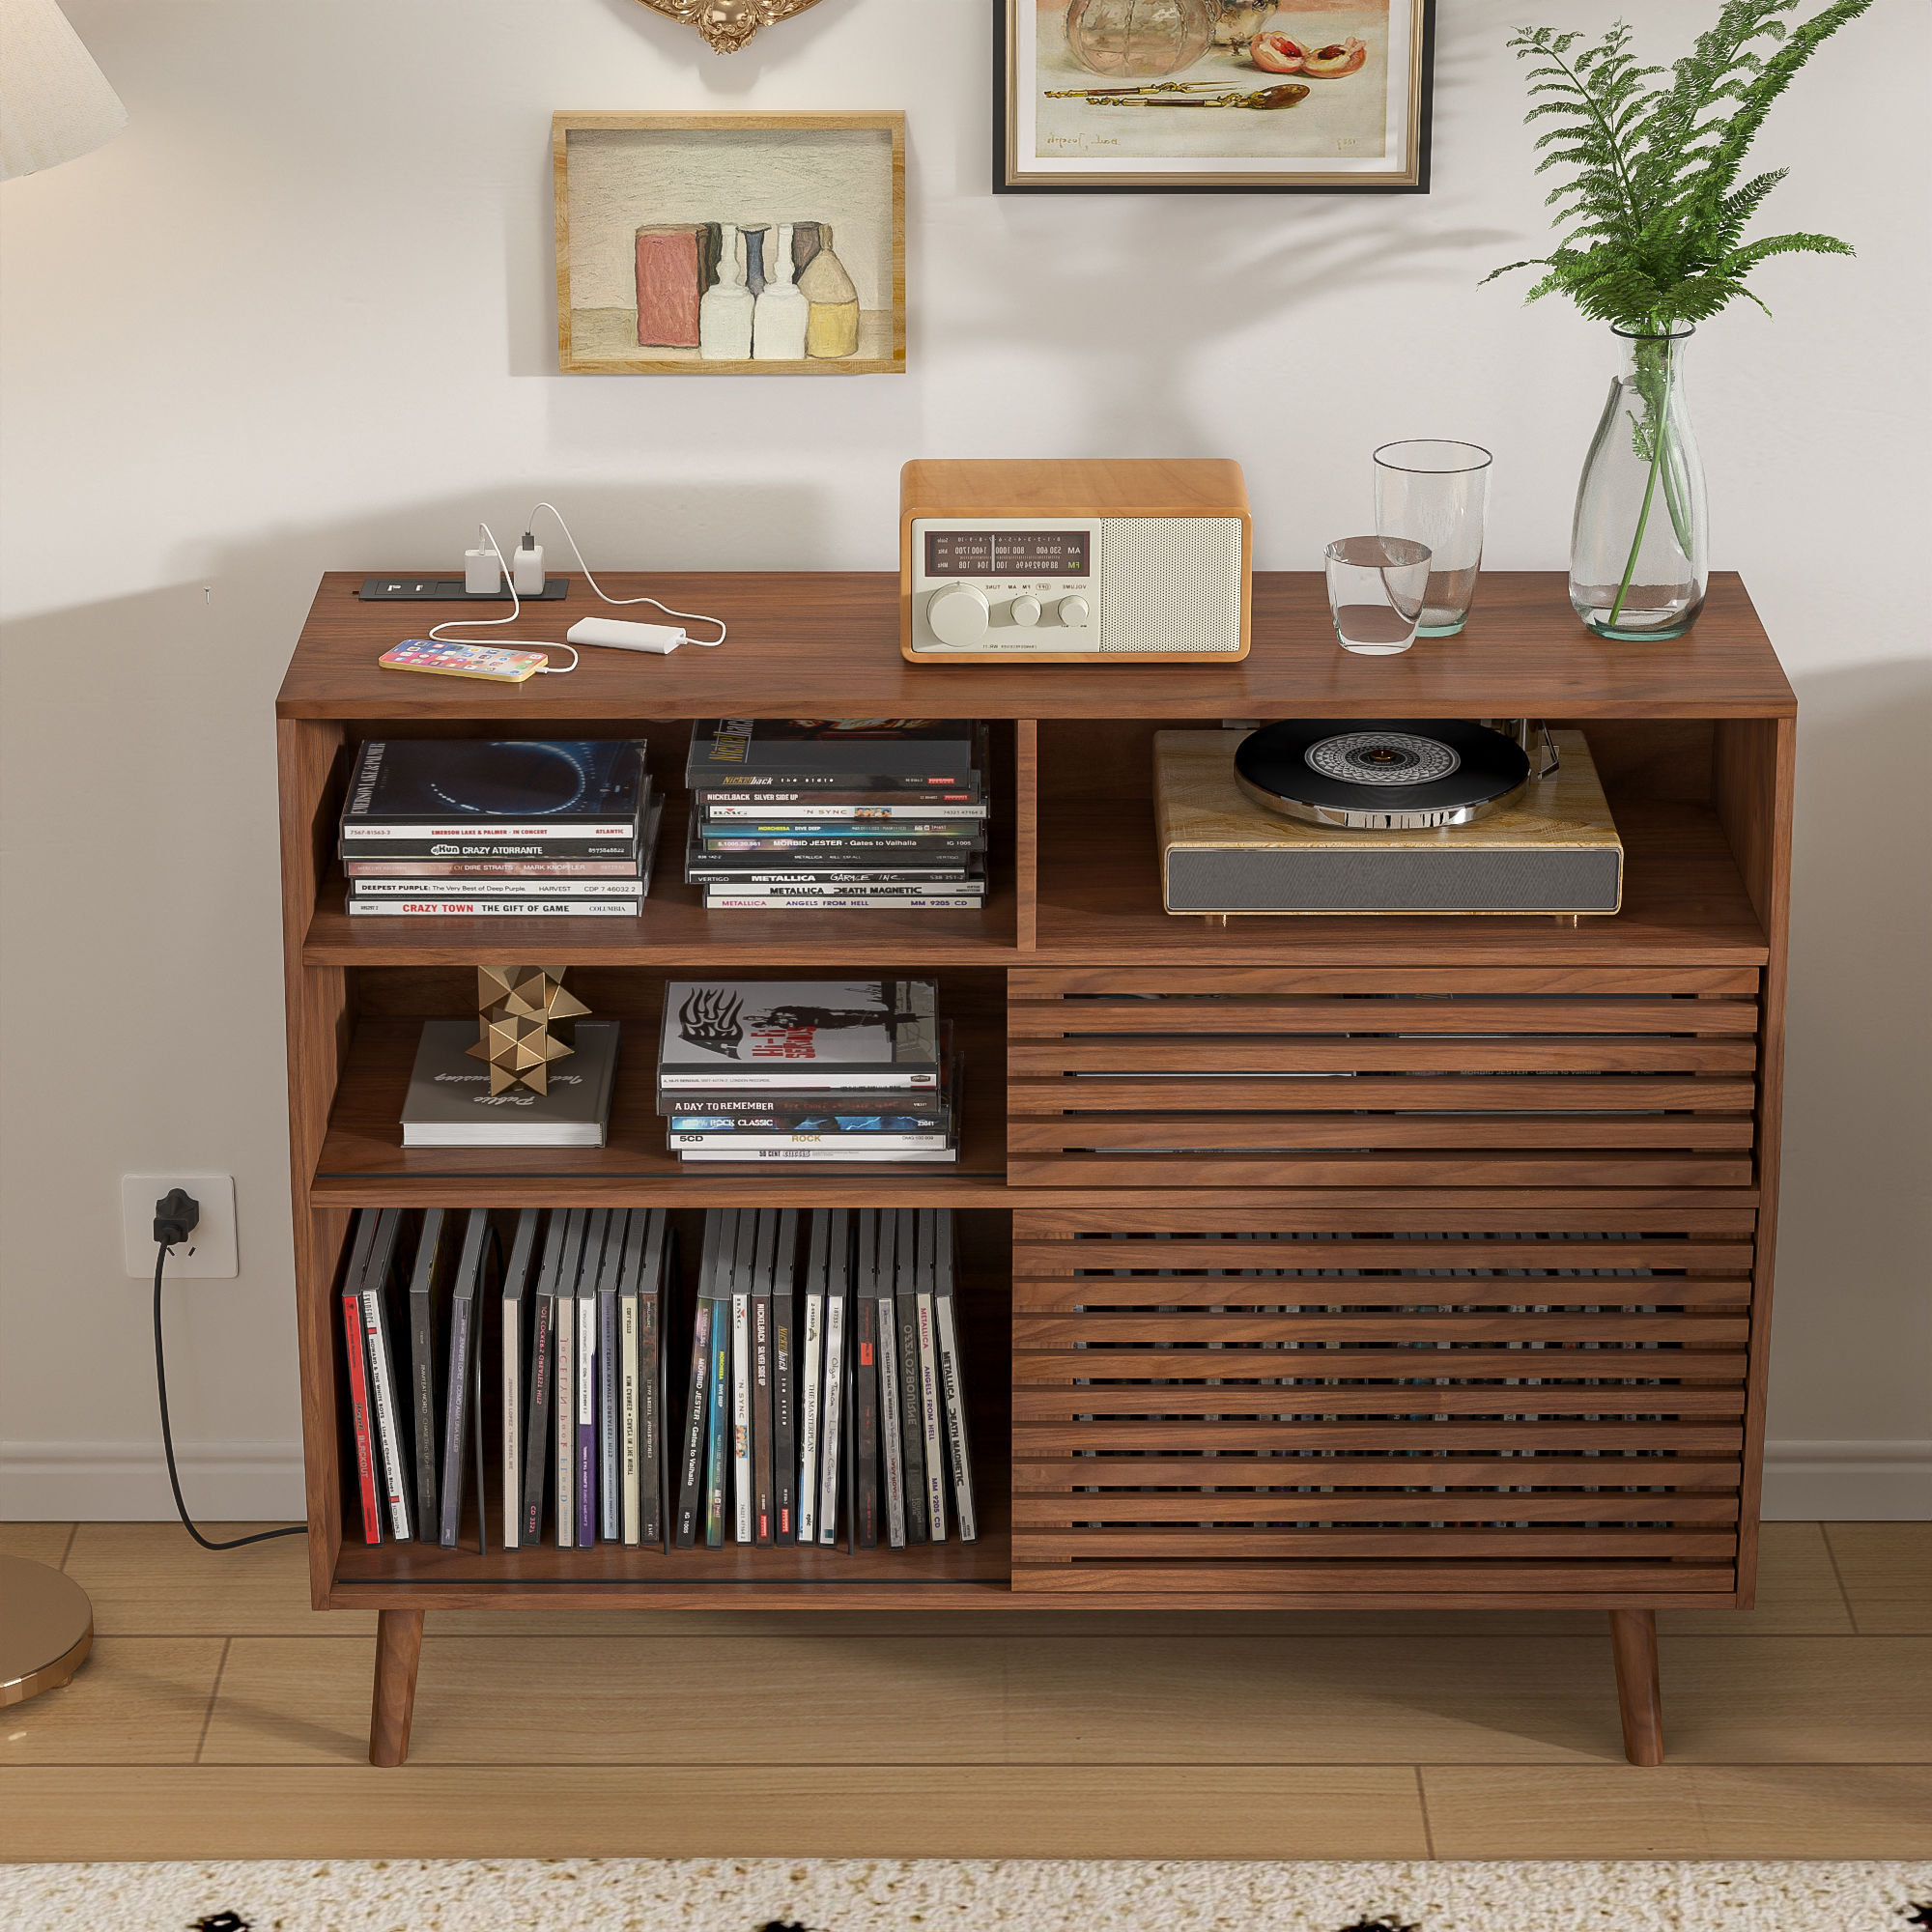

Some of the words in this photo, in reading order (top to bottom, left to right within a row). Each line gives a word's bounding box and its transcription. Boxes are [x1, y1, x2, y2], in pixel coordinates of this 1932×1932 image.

[722, 776, 774, 785] Nickelback
[462, 846, 491, 855] CRAZY
[492, 846, 544, 855] ATORRANTE
[402, 904, 439, 913] CRAZY
[441, 904, 474, 913] TOWN
[481, 904, 500, 913] THE
[502, 904, 525, 913] GIFT
[526, 904, 540, 913] OF
[542, 904, 570, 913] GAME
[434, 1072, 491, 1083] ousing
[472, 1095, 536, 1106] Public
[674, 1102, 683, 1111] A
[683, 1102, 704, 1111] DAY
[705, 1102, 720, 1111] TO
[720, 1101, 774, 1111] REMEMBER
[791, 1134, 822, 1143] ROCK
[756, 1303, 765, 1343] NICKELBACK
[920, 1307, 929, 1350] METALLICA
[757, 1345, 766, 1365] SILVER
[696, 1357, 705, 1389] MORBID
[757, 1365, 766, 1378] SIDE
[828, 1357, 839, 1379] Olga
[943, 1350, 955, 1401] METALLICA
[757, 1378, 766, 1386] UP
[923, 1365, 932, 1396] ANGELS
[369, 1338, 378, 1365] HOWARD
[387, 1466, 393, 1476] On
[693, 1390, 702, 1421] JESTER
[807, 1400, 815, 1453] MASTERPLAN
[949, 1407, 959, 1438] DEATH
[690, 1426, 699, 1448] Gates
[357, 1435, 368, 1479] BLACKOUT
[952, 1439, 965, 1487] MAGNETIC
[687, 1458, 696, 1487] Valhalla
[931, 1477, 939, 1492] MM
[934, 1516, 941, 1529] CD
